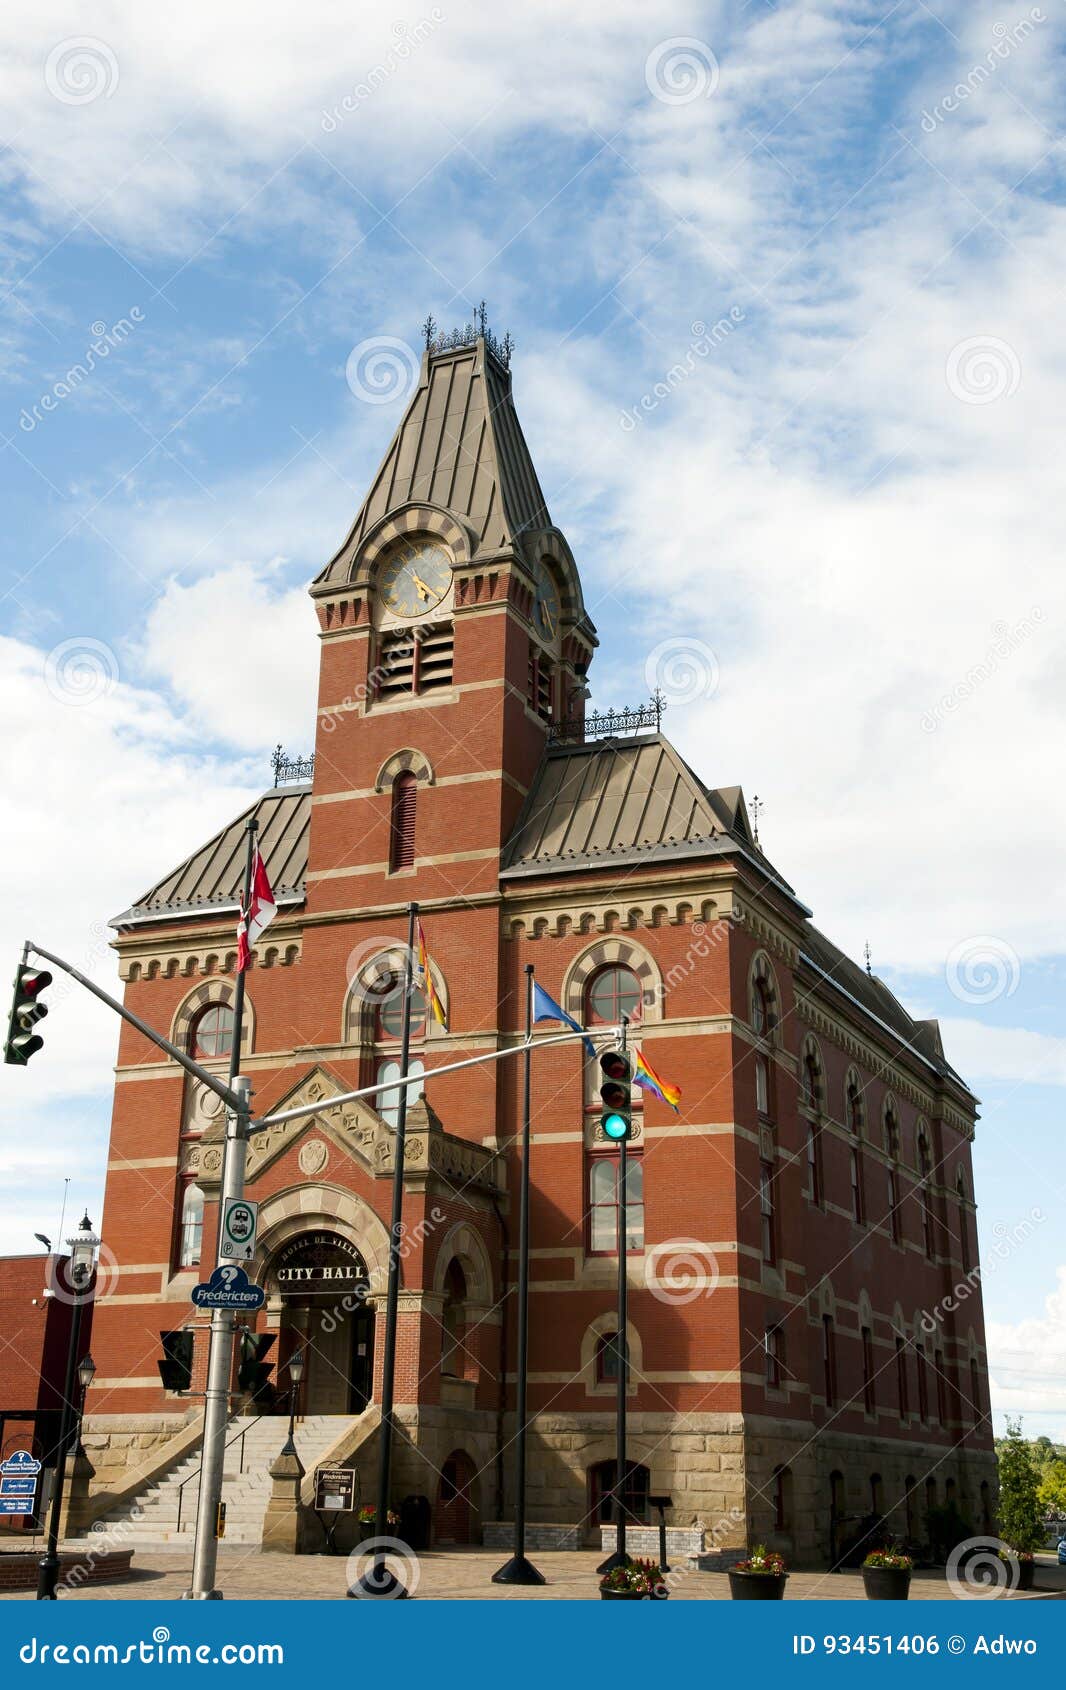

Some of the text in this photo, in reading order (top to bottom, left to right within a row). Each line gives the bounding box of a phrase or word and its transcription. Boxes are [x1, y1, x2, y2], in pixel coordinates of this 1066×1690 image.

[332, 1237, 359, 1259] VILLE
[277, 1266, 363, 1280] CITY HALL
